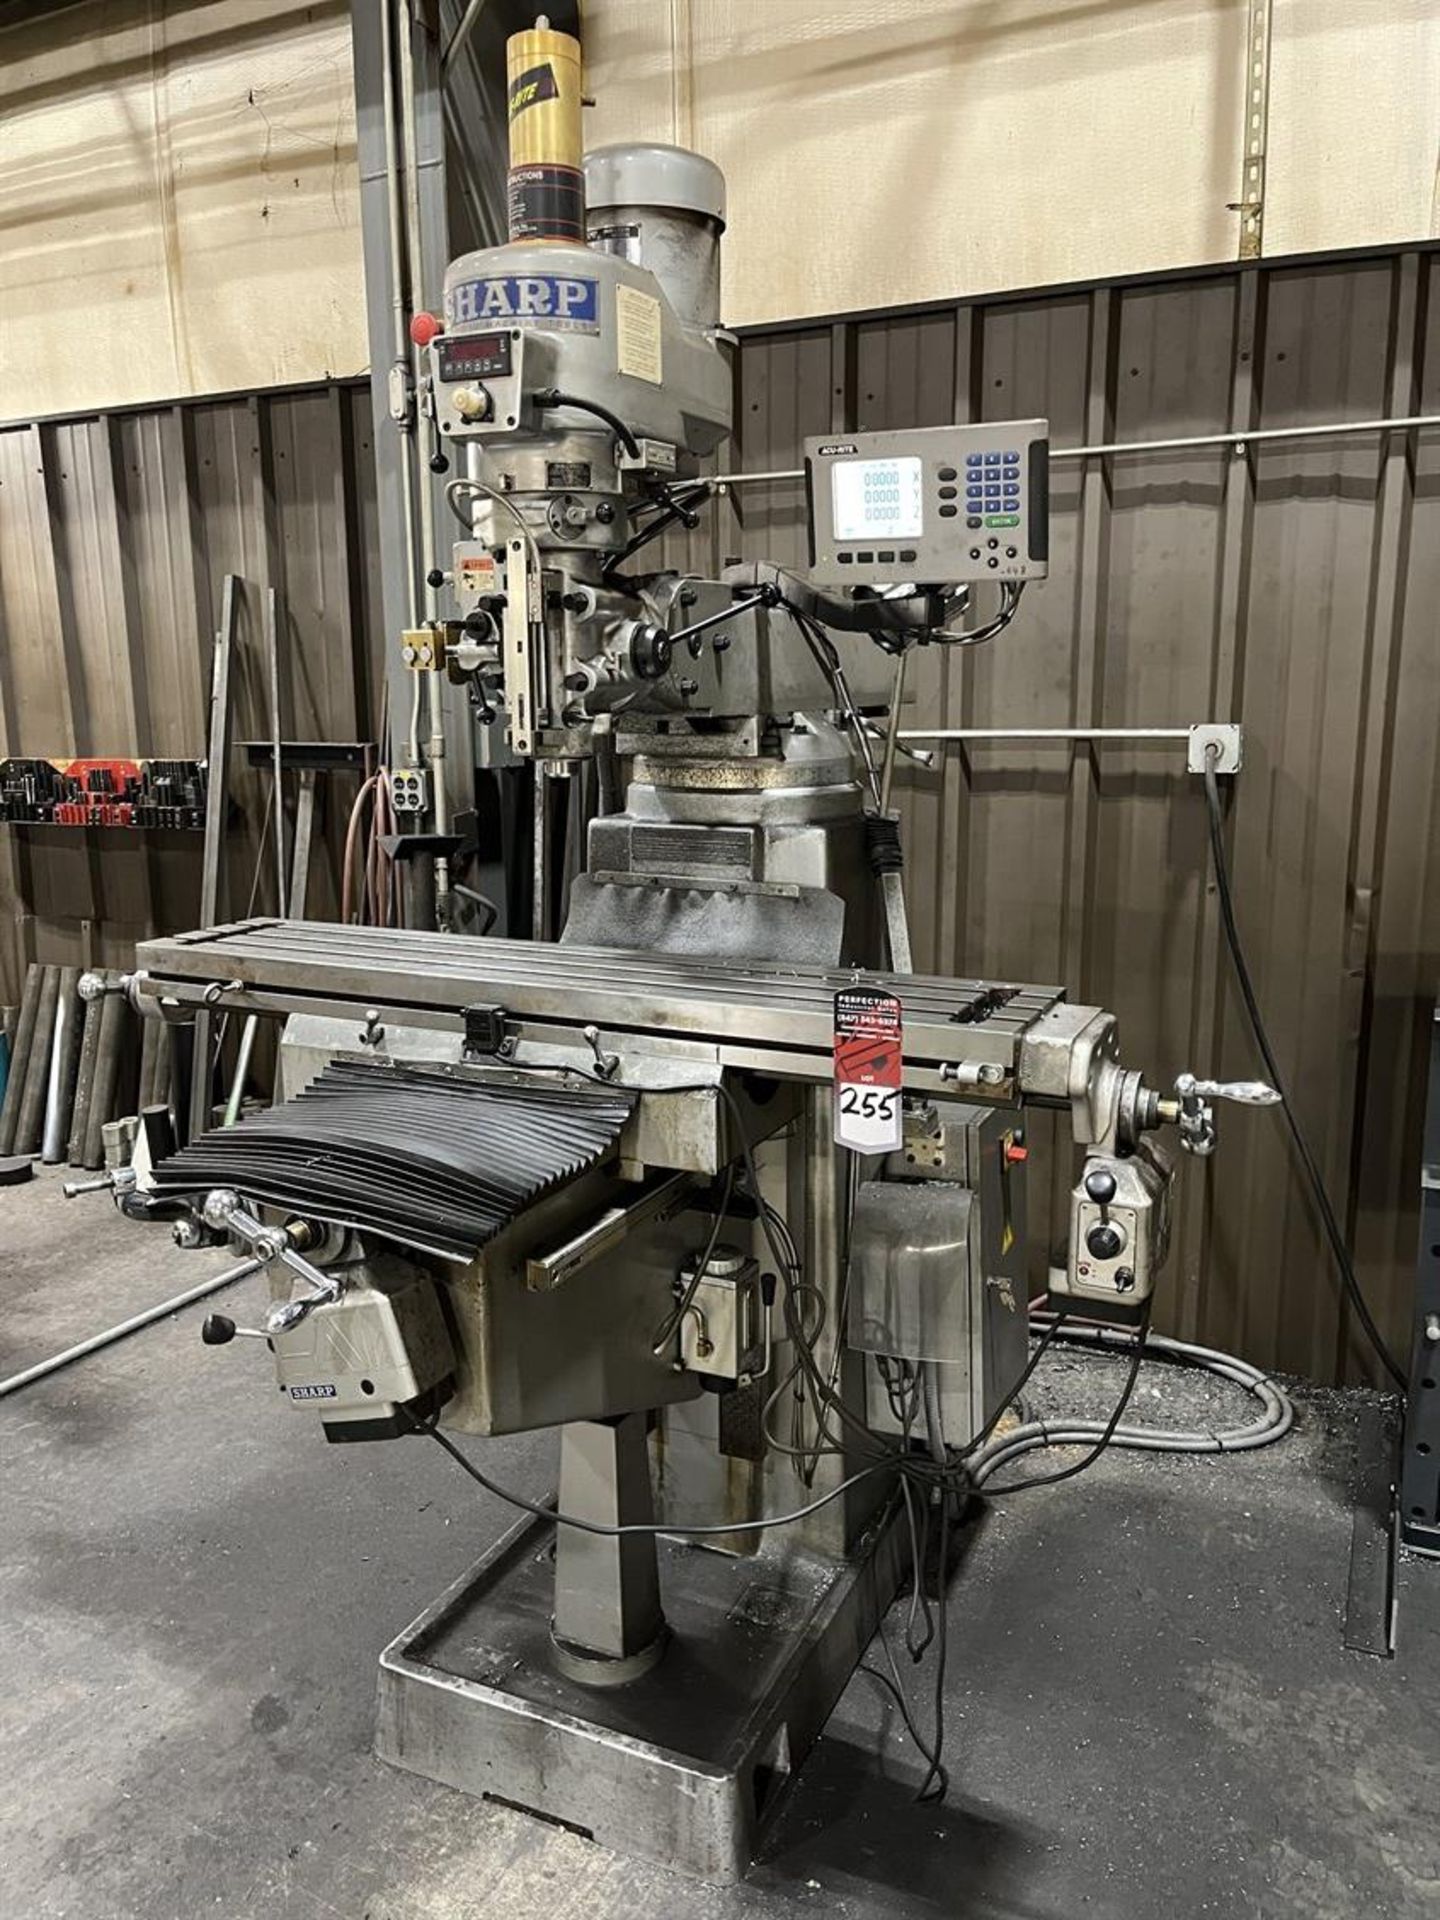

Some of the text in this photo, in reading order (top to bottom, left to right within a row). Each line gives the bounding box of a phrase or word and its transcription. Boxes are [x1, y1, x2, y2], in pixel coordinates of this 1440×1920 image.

[838, 995, 898, 1007] PERFECTION
[840, 1086, 902, 1121] 255
[292, 1387, 333, 1398] SHARP
